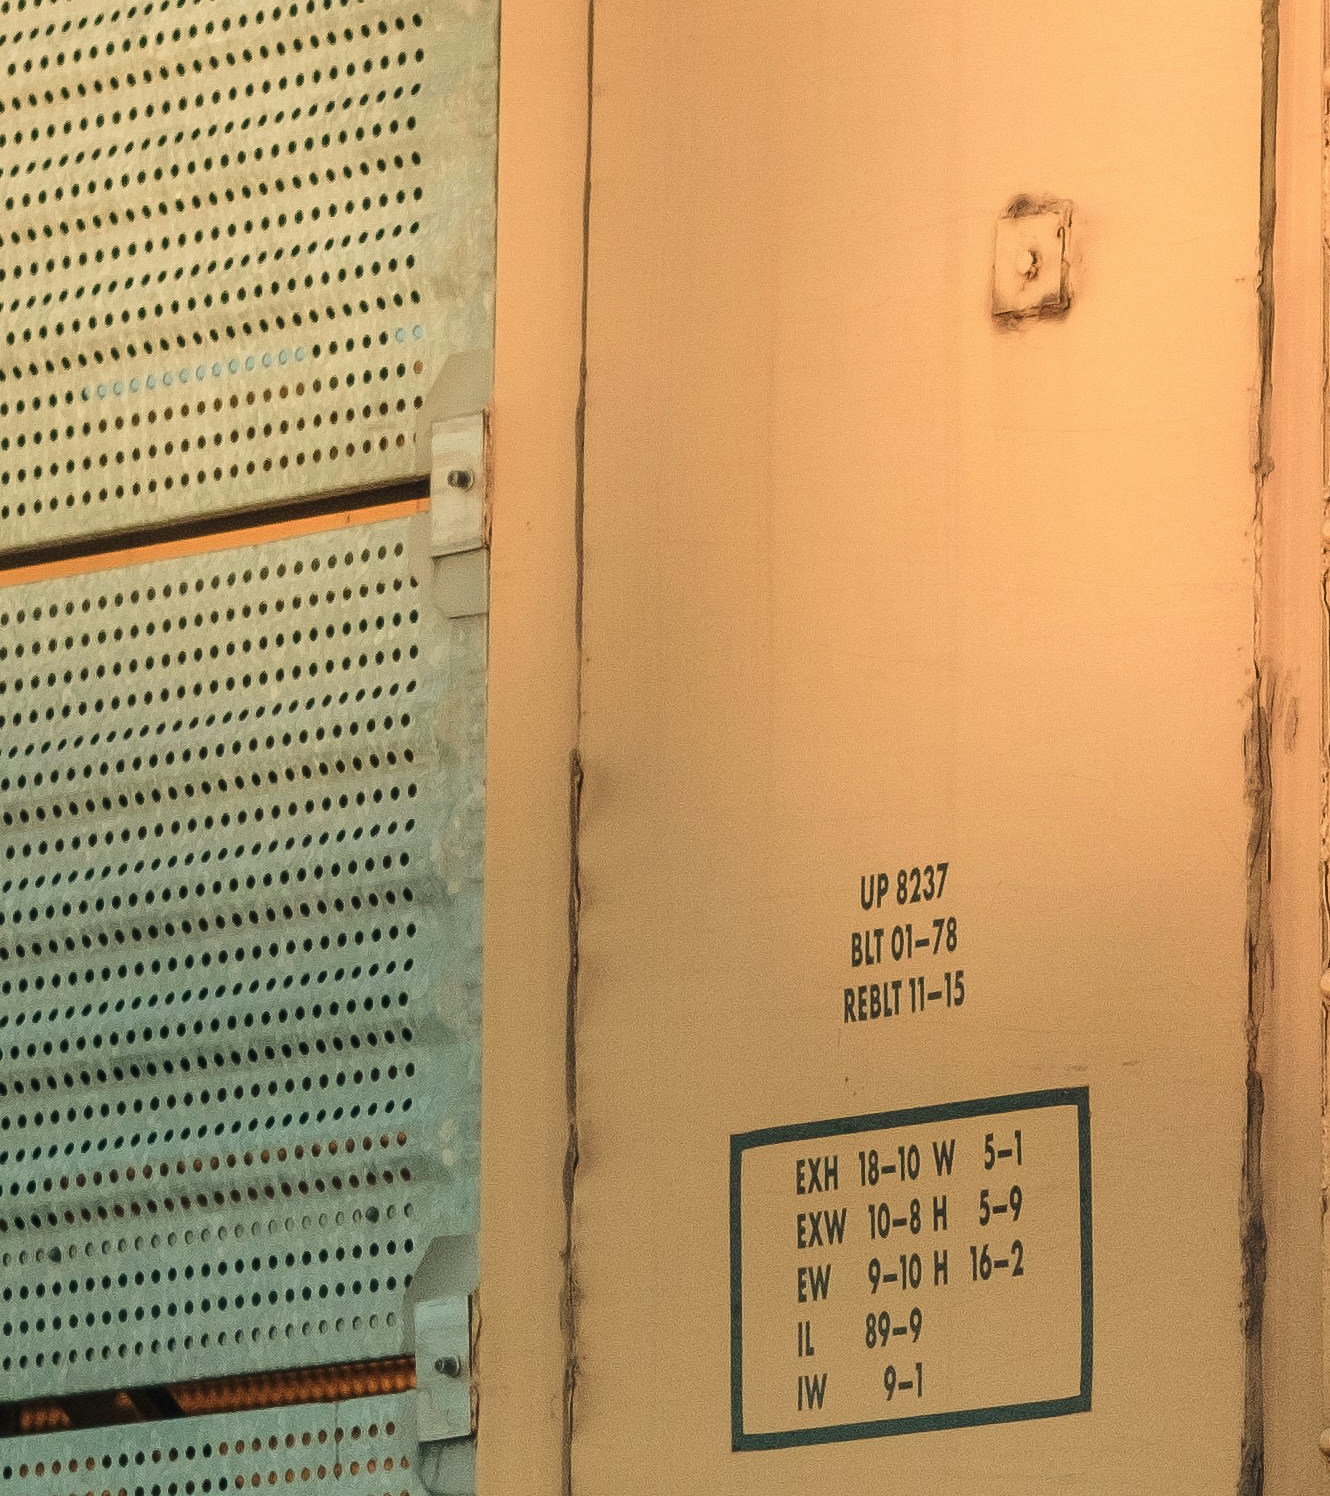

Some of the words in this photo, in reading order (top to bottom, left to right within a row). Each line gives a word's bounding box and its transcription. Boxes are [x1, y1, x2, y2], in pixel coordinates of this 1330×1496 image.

[861, 872, 889, 910] UP
[896, 863, 949, 905] 8237
[851, 929, 884, 967] BLT
[891, 917, 957, 959] 01-78
[844, 980, 902, 1024] REBLT
[909, 970, 966, 1013] 11-15
[796, 1157, 838, 1194] EXH
[858, 1144, 920, 1187] 18-10
[933, 1140, 955, 1176] W
[984, 1130, 1023, 1169] 5-1
[797, 1209, 846, 1248] EXW
[868, 1199, 921, 1240] 10-8
[933, 1196, 947, 1231] H
[979, 1186, 1023, 1225] 5-9
[798, 1264, 830, 1303] EW
[868, 1252, 921, 1294] 9-10
[934, 1250, 948, 1285] H
[970, 1240, 1024, 1282] 16-2
[798, 1321, 814, 1357] IL
[865, 1307, 922, 1349] 89-9
[798, 1373, 827, 1411] IW
[884, 1362, 923, 1401] 9-1
